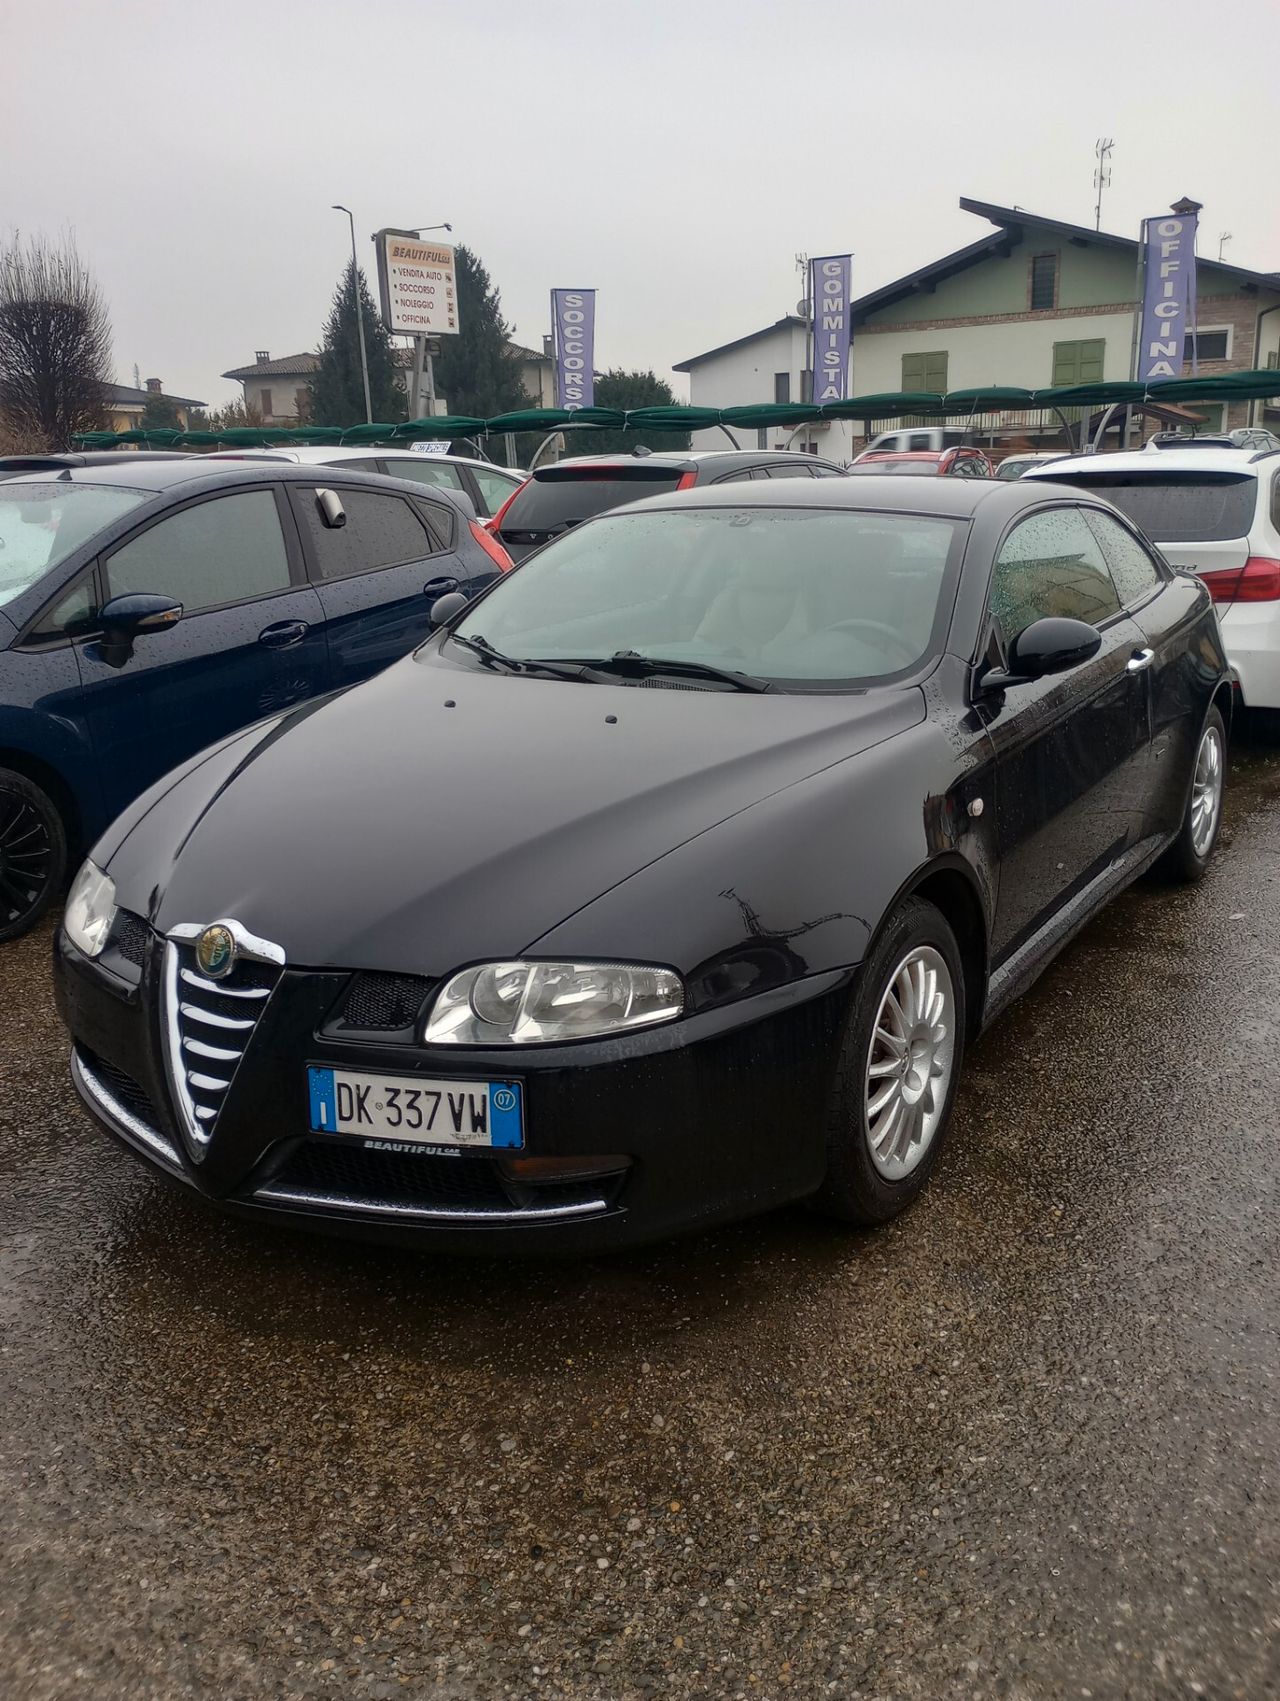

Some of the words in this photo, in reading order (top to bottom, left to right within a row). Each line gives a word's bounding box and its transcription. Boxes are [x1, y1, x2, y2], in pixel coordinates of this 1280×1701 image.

[392, 246, 442, 263] BEAUTIFUL
[398, 267, 425, 279] VENDITA
[426, 271, 442, 281] AUTO
[399, 283, 435, 294] SOCCORSO
[400, 299, 434, 309] NOLEGGIO
[1147, 220, 1182, 376] OFFICINA
[402, 314, 431, 324] OFFICINA
[820, 261, 843, 399] GOMMISTA
[337, 1082, 373, 1124] DK
[497, 1092, 511, 1106] 07
[364, 1140, 442, 1155] BEAUTIFUL
